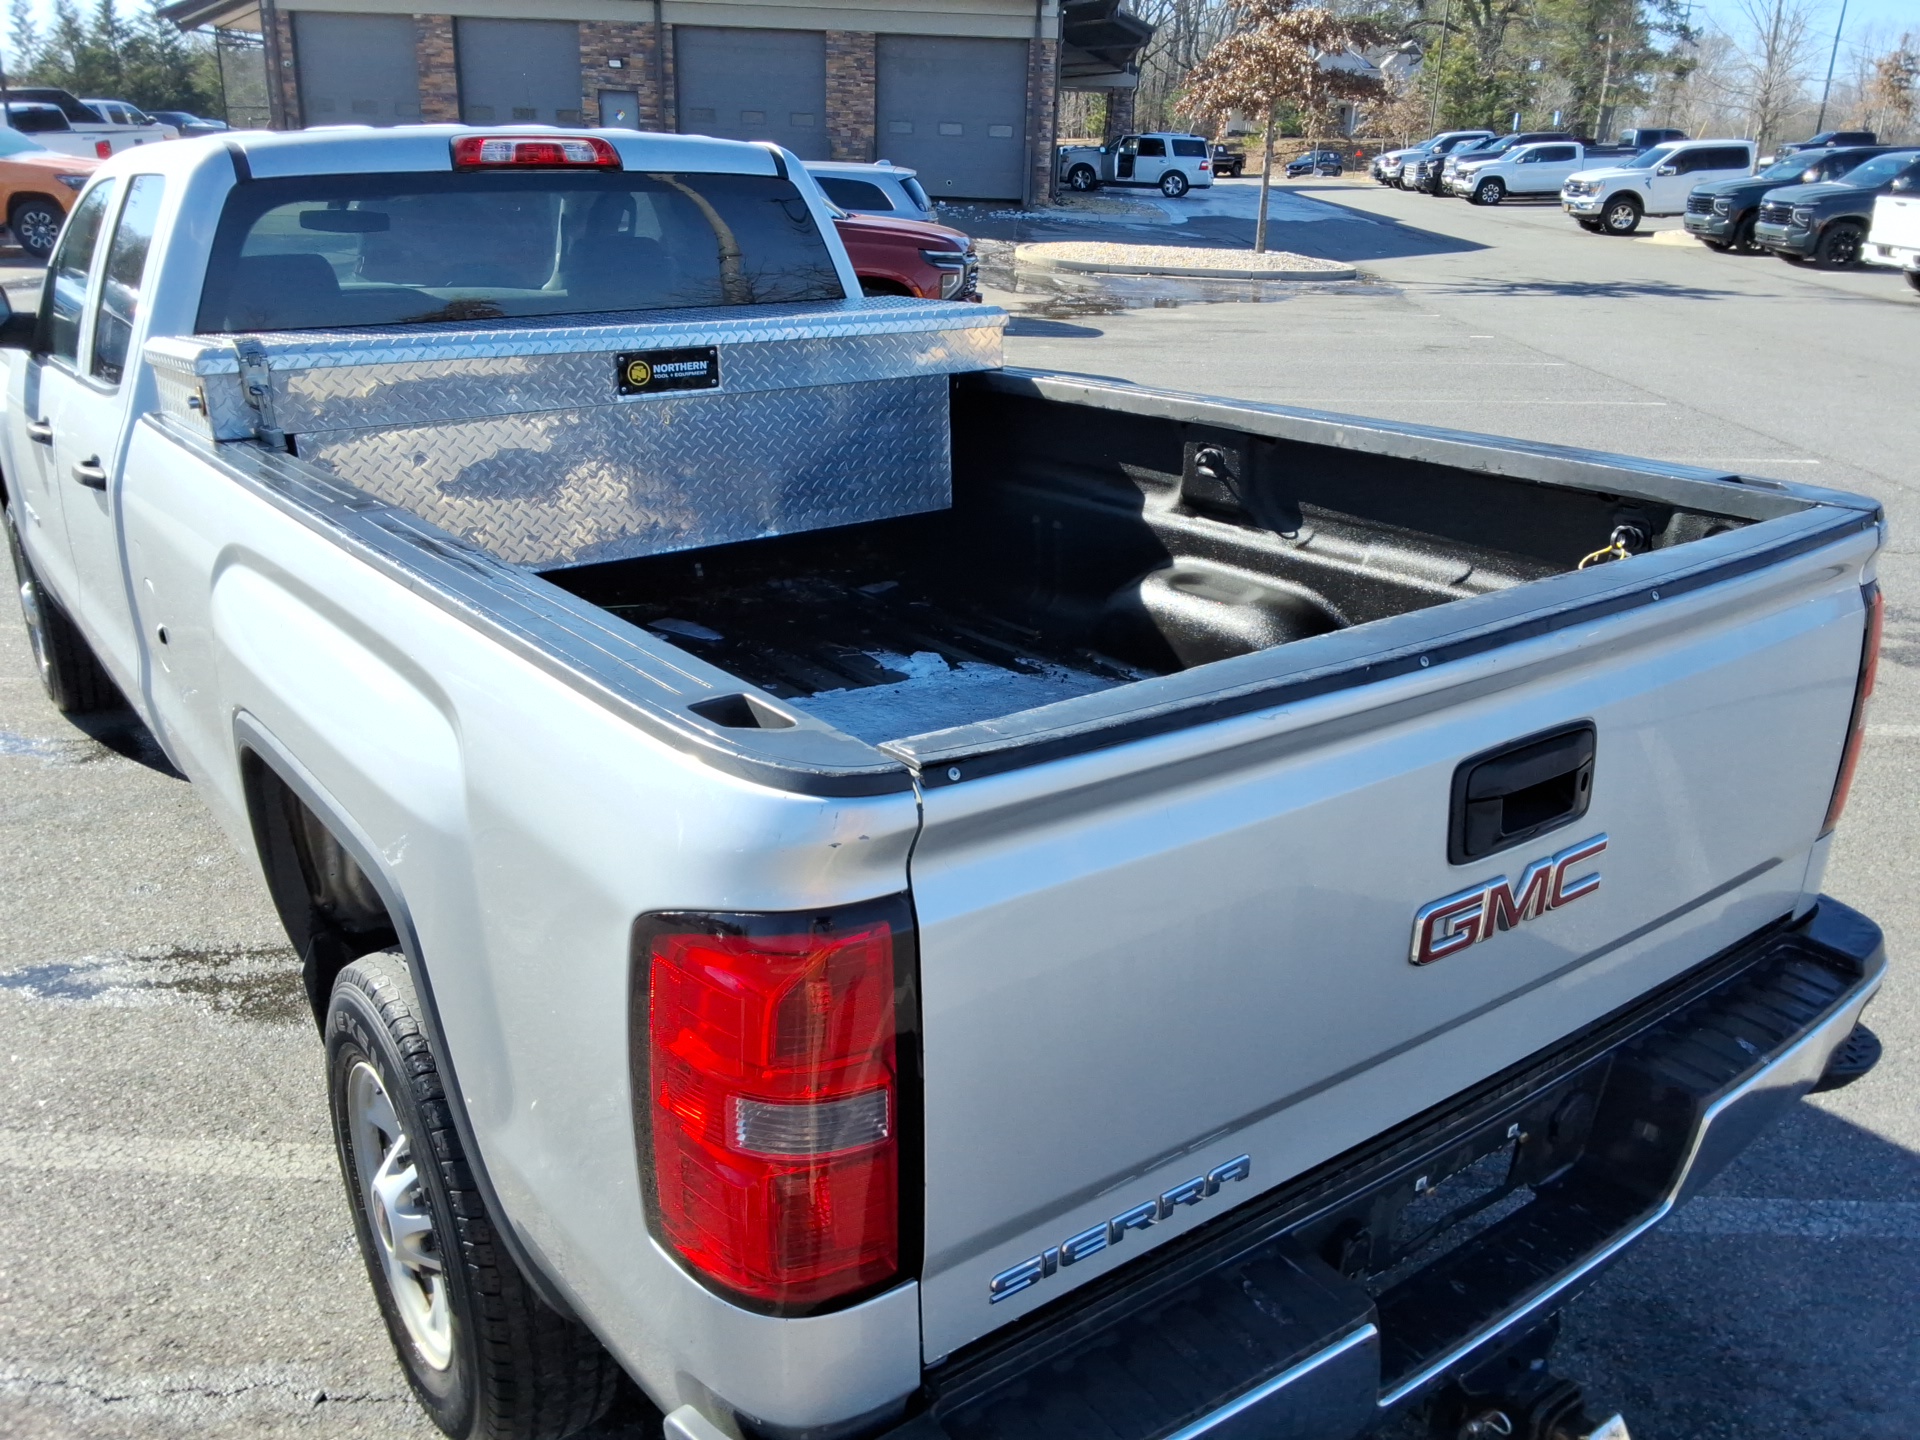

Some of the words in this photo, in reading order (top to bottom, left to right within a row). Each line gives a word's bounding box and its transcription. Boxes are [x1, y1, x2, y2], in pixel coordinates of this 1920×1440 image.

[652, 361, 708, 373] NORTHERN
[1408, 831, 1609, 966] GMC
[989, 1153, 1250, 1304] SIERRA
